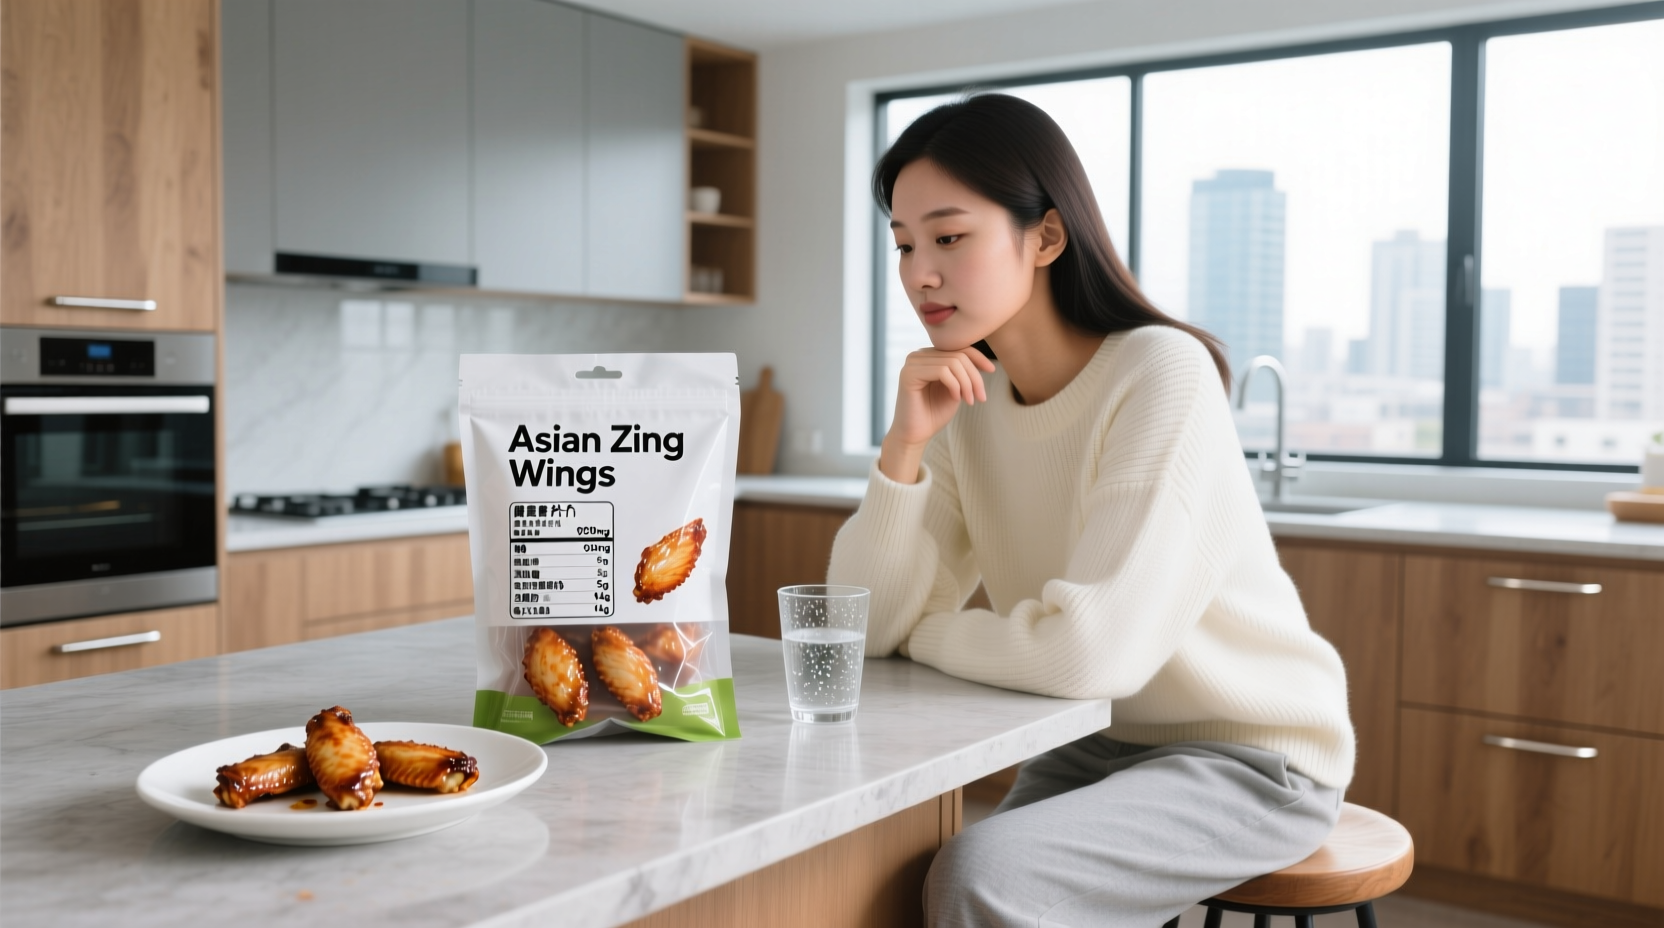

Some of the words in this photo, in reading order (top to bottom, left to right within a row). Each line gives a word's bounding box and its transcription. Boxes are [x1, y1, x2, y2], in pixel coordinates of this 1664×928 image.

[508, 424, 601, 453] Asian
[610, 424, 684, 461] Zing
[509, 458, 616, 494] Wings
